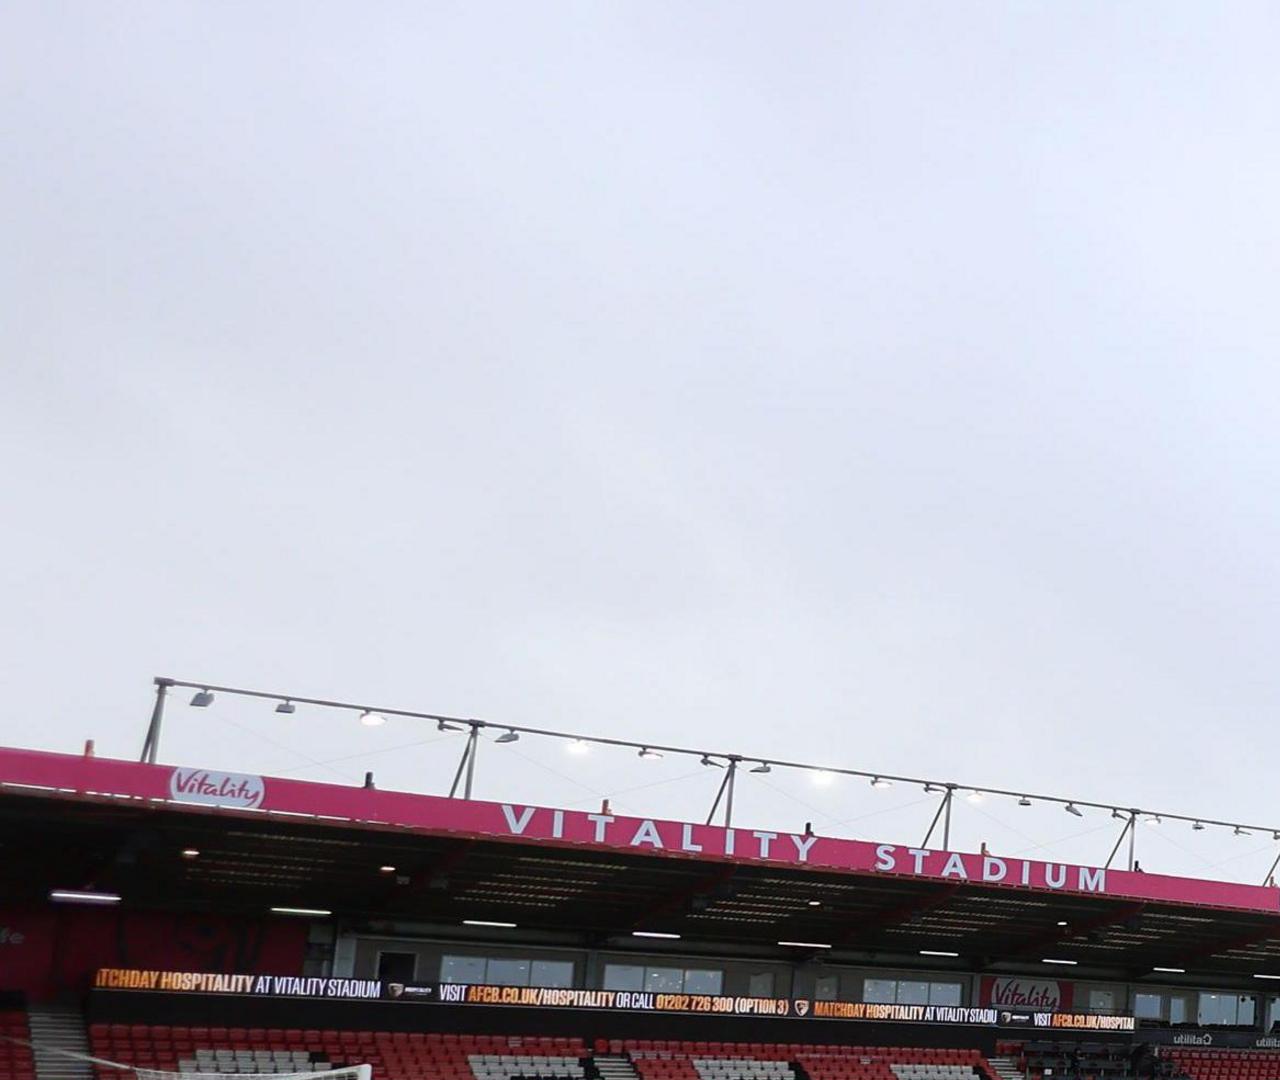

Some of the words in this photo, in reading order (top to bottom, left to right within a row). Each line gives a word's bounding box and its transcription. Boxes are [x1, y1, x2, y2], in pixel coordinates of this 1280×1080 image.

[176, 769, 260, 807] Vitality
[502, 804, 817, 861] VITALITY
[876, 845, 1106, 892] STADIUM
[162, 972, 253, 993] HOSPITALITY
[256, 976, 273, 993] AT
[274, 977, 327, 996] VITALITY
[328, 979, 380, 998] STADIUM
[996, 979, 1057, 1012] Vitality
[439, 984, 467, 1001] VISIT
[468, 985, 616, 1008] AFCB.CO.UK/HOSPITALITY
[616, 992, 631, 1008] OR
[631, 993, 654, 1009] CALL
[656, 994, 689, 1011] 01202
[691, 996, 711, 1012] 726
[712, 997, 733, 1012] 300
[735, 997, 777, 1014] (OPTION
[777, 1000, 789, 1015] 3)
[814, 1002, 866, 1018] MATCHDAY
[866, 1004, 924, 1021] HOSPITALITY
[925, 1007, 936, 1021] AT
[937, 1007, 969, 1022] VITALITY
[1034, 1012, 1051, 1027] VISIT
[1174, 1034, 1202, 1045] utilita
